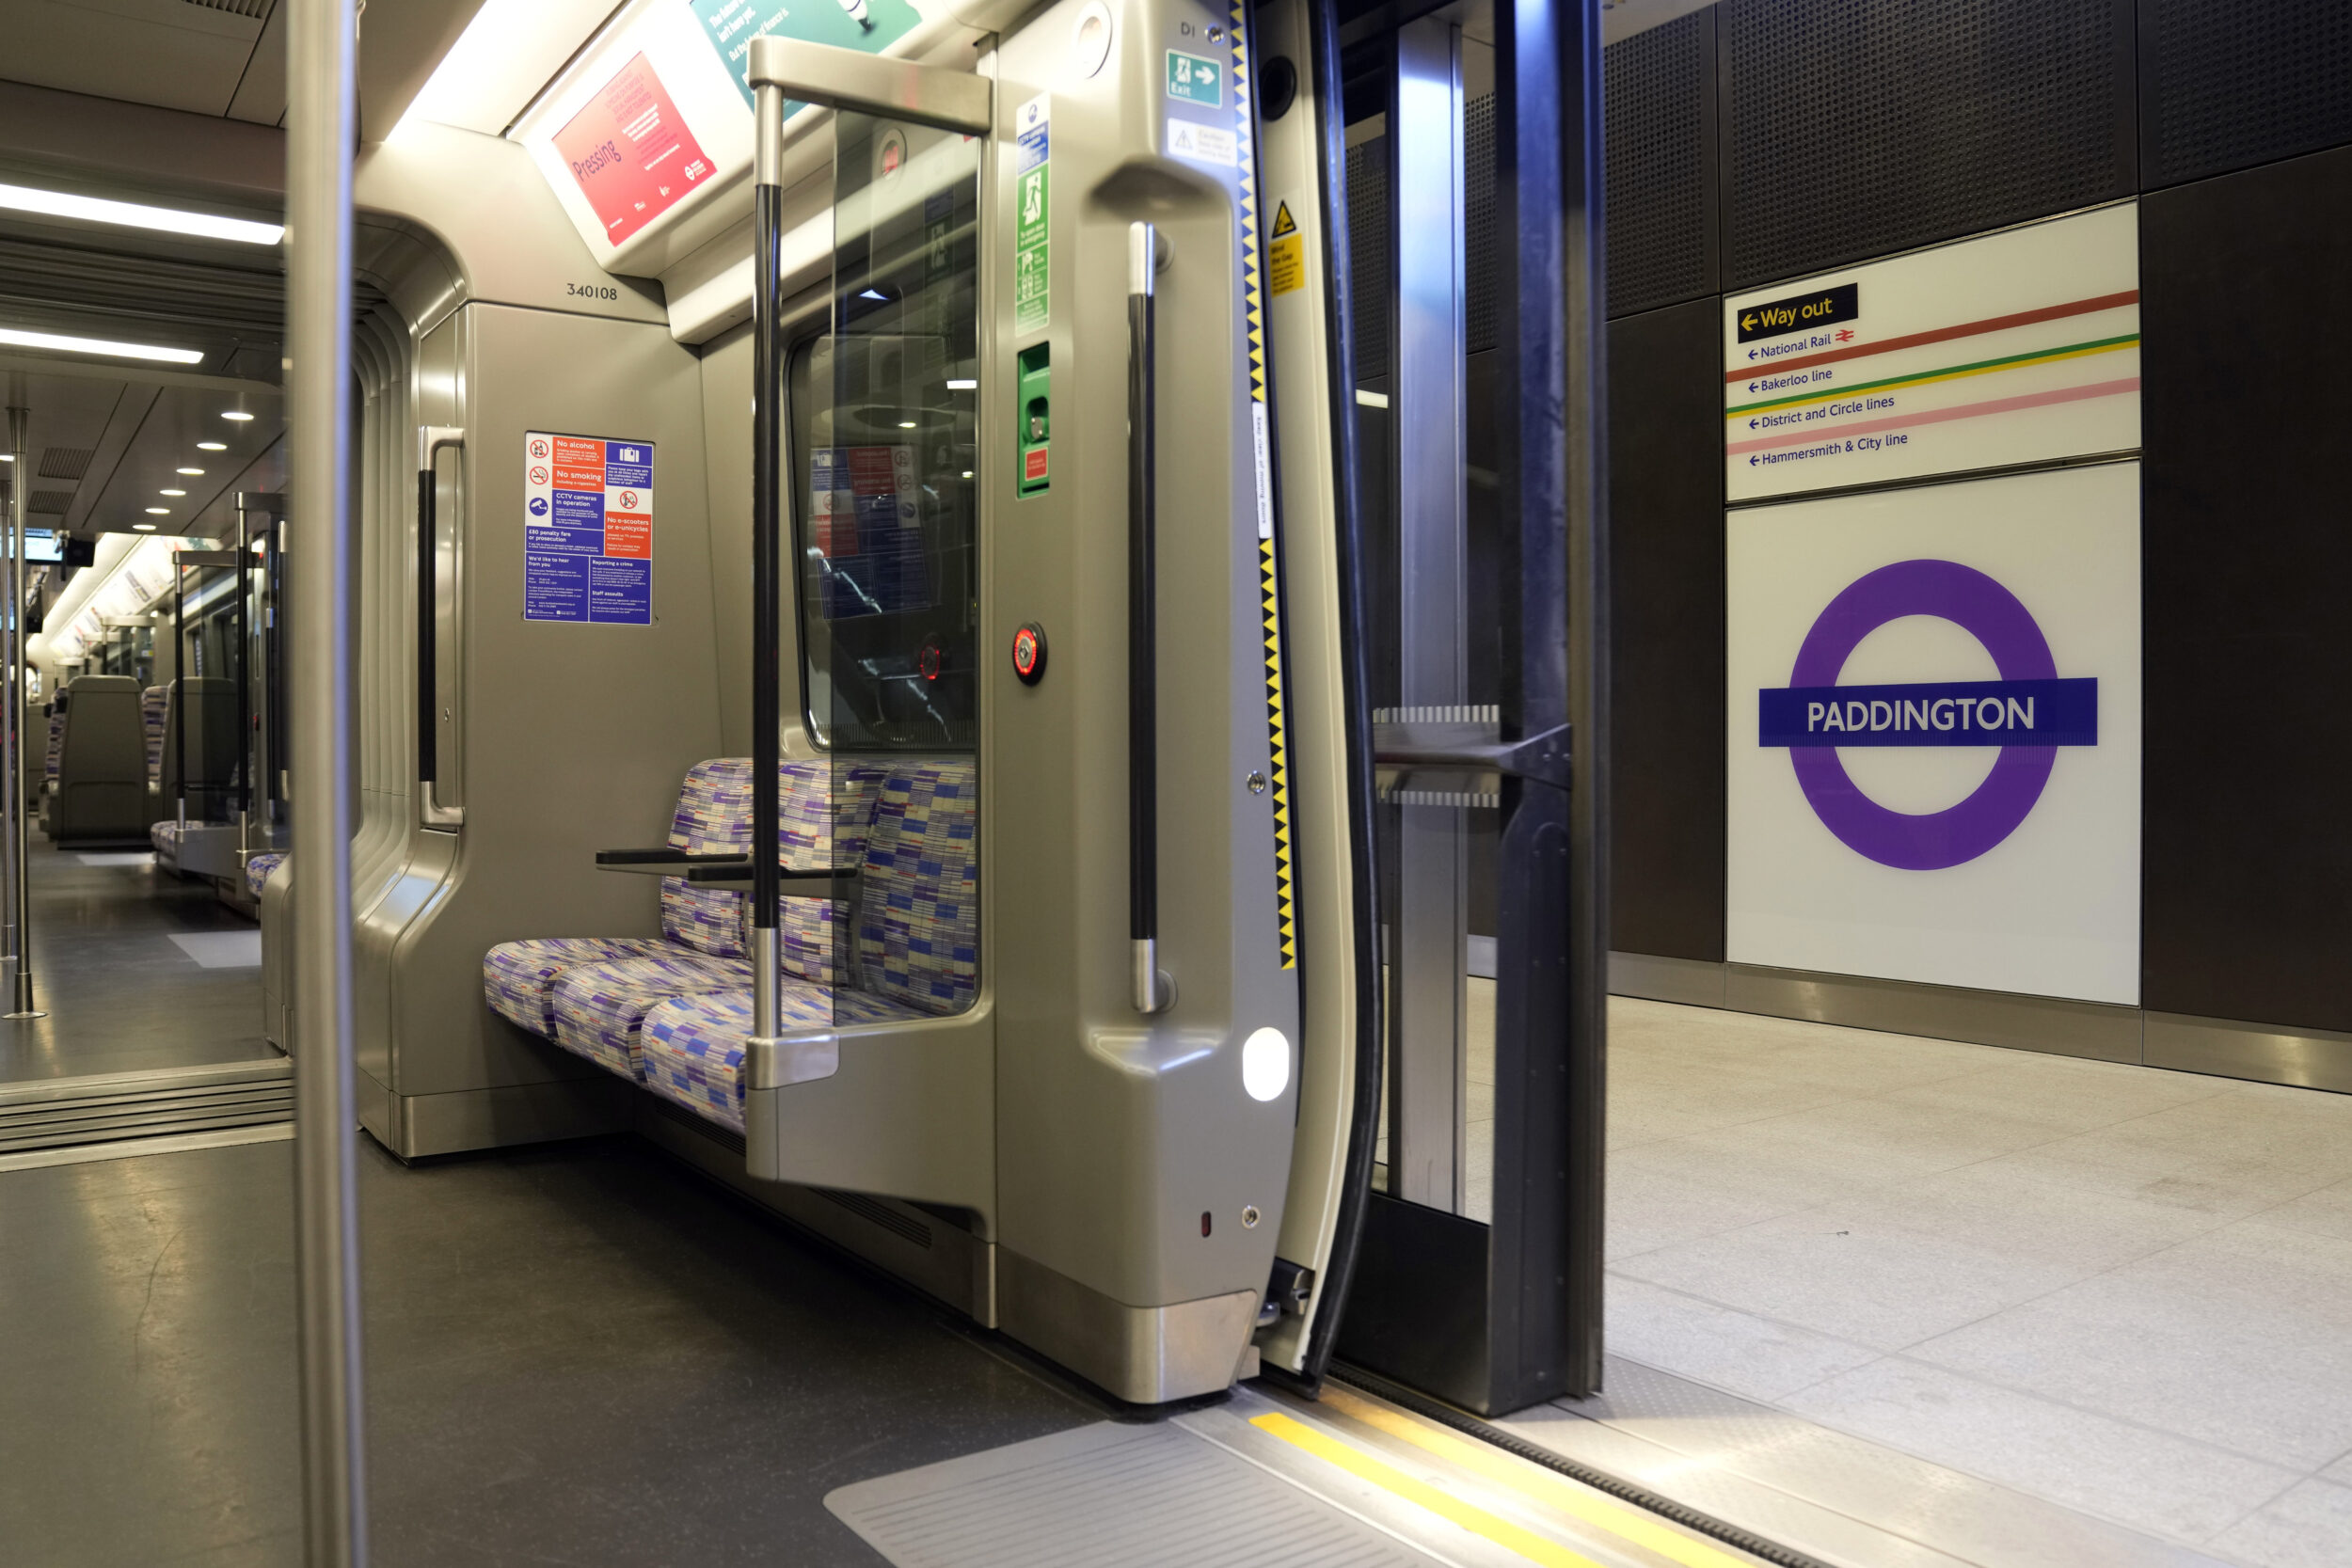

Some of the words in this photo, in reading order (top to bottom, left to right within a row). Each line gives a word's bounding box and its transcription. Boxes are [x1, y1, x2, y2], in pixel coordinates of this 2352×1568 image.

[1170, 81, 1192, 97] Exit
[573, 139, 623, 182] Pressing
[566, 283, 617, 300] 340108
[1760, 306, 1796, 327] Way
[1802, 297, 1833, 319] out
[1760, 340, 1807, 358] National
[1810, 333, 1831, 348] Rail
[1761, 372, 1808, 391] Bakerloo
[1812, 369, 1833, 382] line
[1762, 411, 1802, 428] District
[1805, 406, 1826, 420] and
[1830, 400, 1863, 417] Circle
[1867, 396, 1895, 410] lines
[569, 441, 595, 450] alcohol
[1762, 442, 1841, 465] Hammersmith
[1845, 440, 1853, 452] &
[1857, 436, 1882, 451] City
[1885, 433, 1908, 446] line
[570, 472, 601, 482] smoking
[615, 525, 648, 533] e-unicycles
[1808, 696, 2034, 732] PADDINGTON
